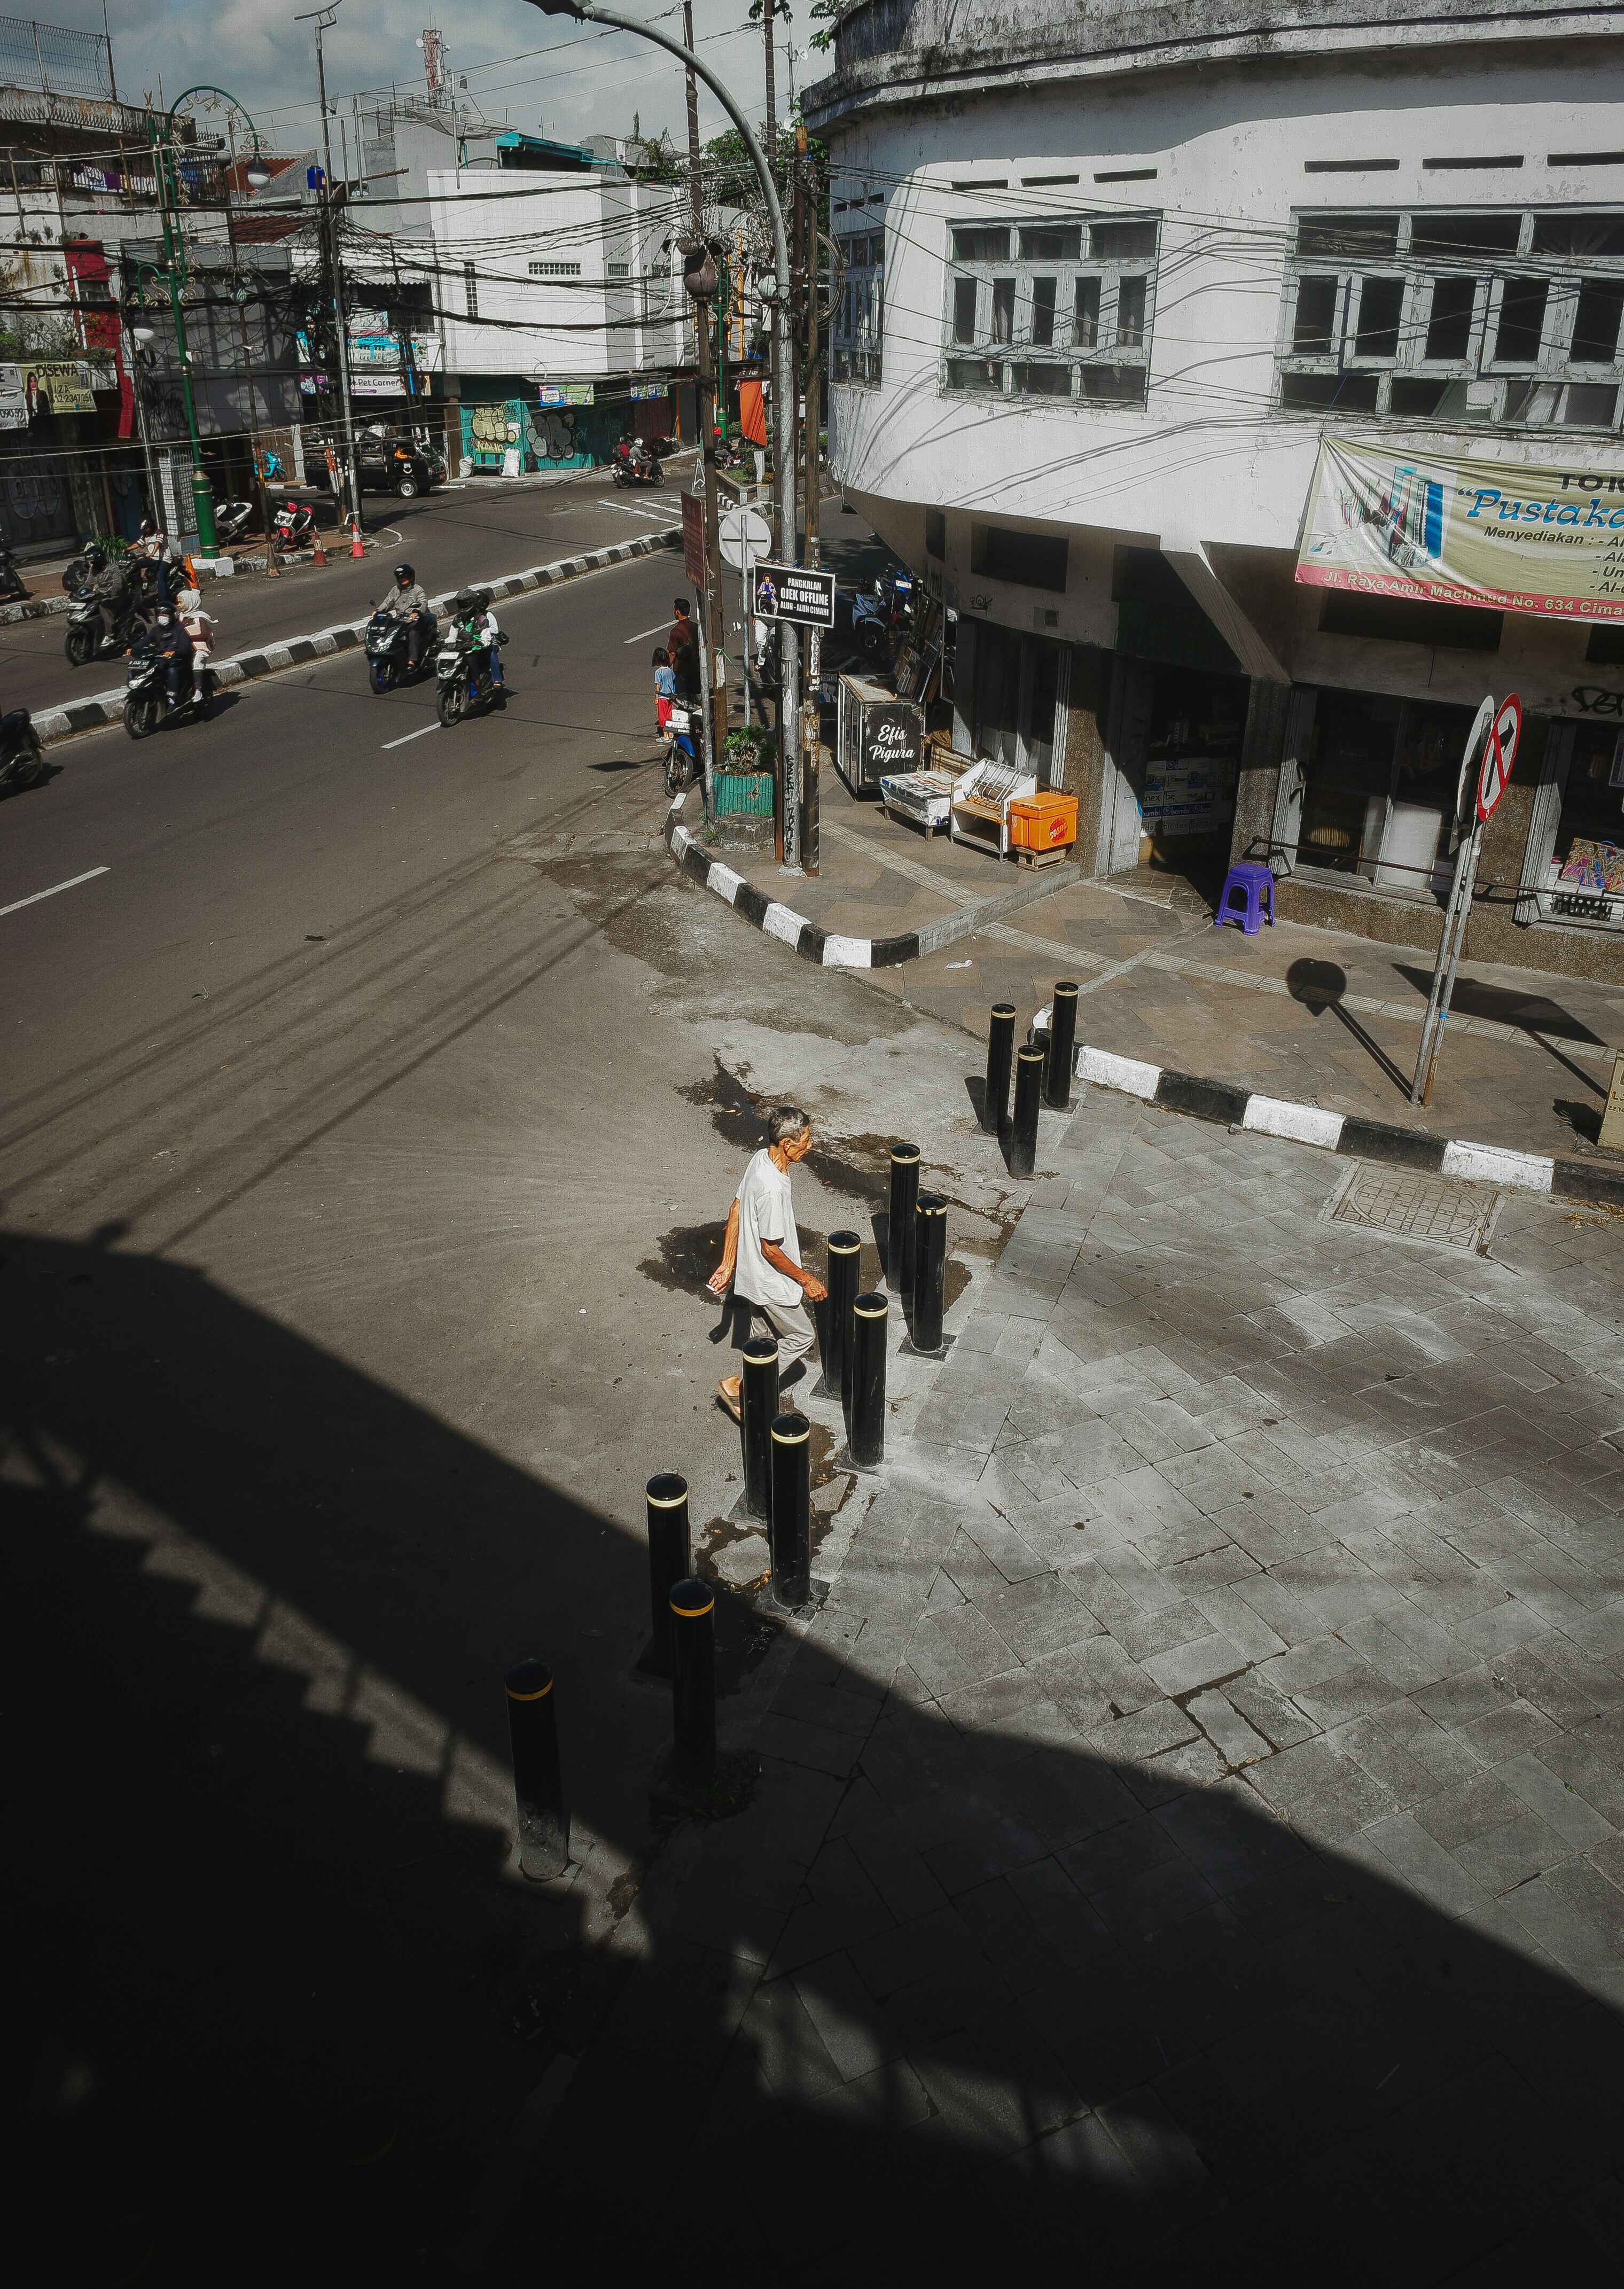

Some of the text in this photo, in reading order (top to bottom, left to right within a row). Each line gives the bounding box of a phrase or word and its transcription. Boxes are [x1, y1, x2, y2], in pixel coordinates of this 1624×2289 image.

[1484, 526, 1583, 546] Menyediakan
[787, 578, 822, 591] PANGKALAN
[1324, 571, 1342, 583] Jl.
[1347, 574, 1385, 589] Raya
[1389, 580, 1426, 594] Amir
[1431, 585, 1506, 604] Machmud
[1512, 593, 1539, 608] No.
[1545, 598, 1574, 611] 634
[780, 588, 829, 606] OJEK OFFLINE
[780, 601, 793, 610] ALUN
[797, 604, 809, 613] ALUN
[810, 605, 829, 617] CIMAHI
[1126, 626, 1229, 668] NASUTION
[877, 725, 908, 745] Efis
[869, 745, 915, 763] Pigura
[1171, 806, 1190, 815] bambi
[1163, 820, 1187, 830] bindex
